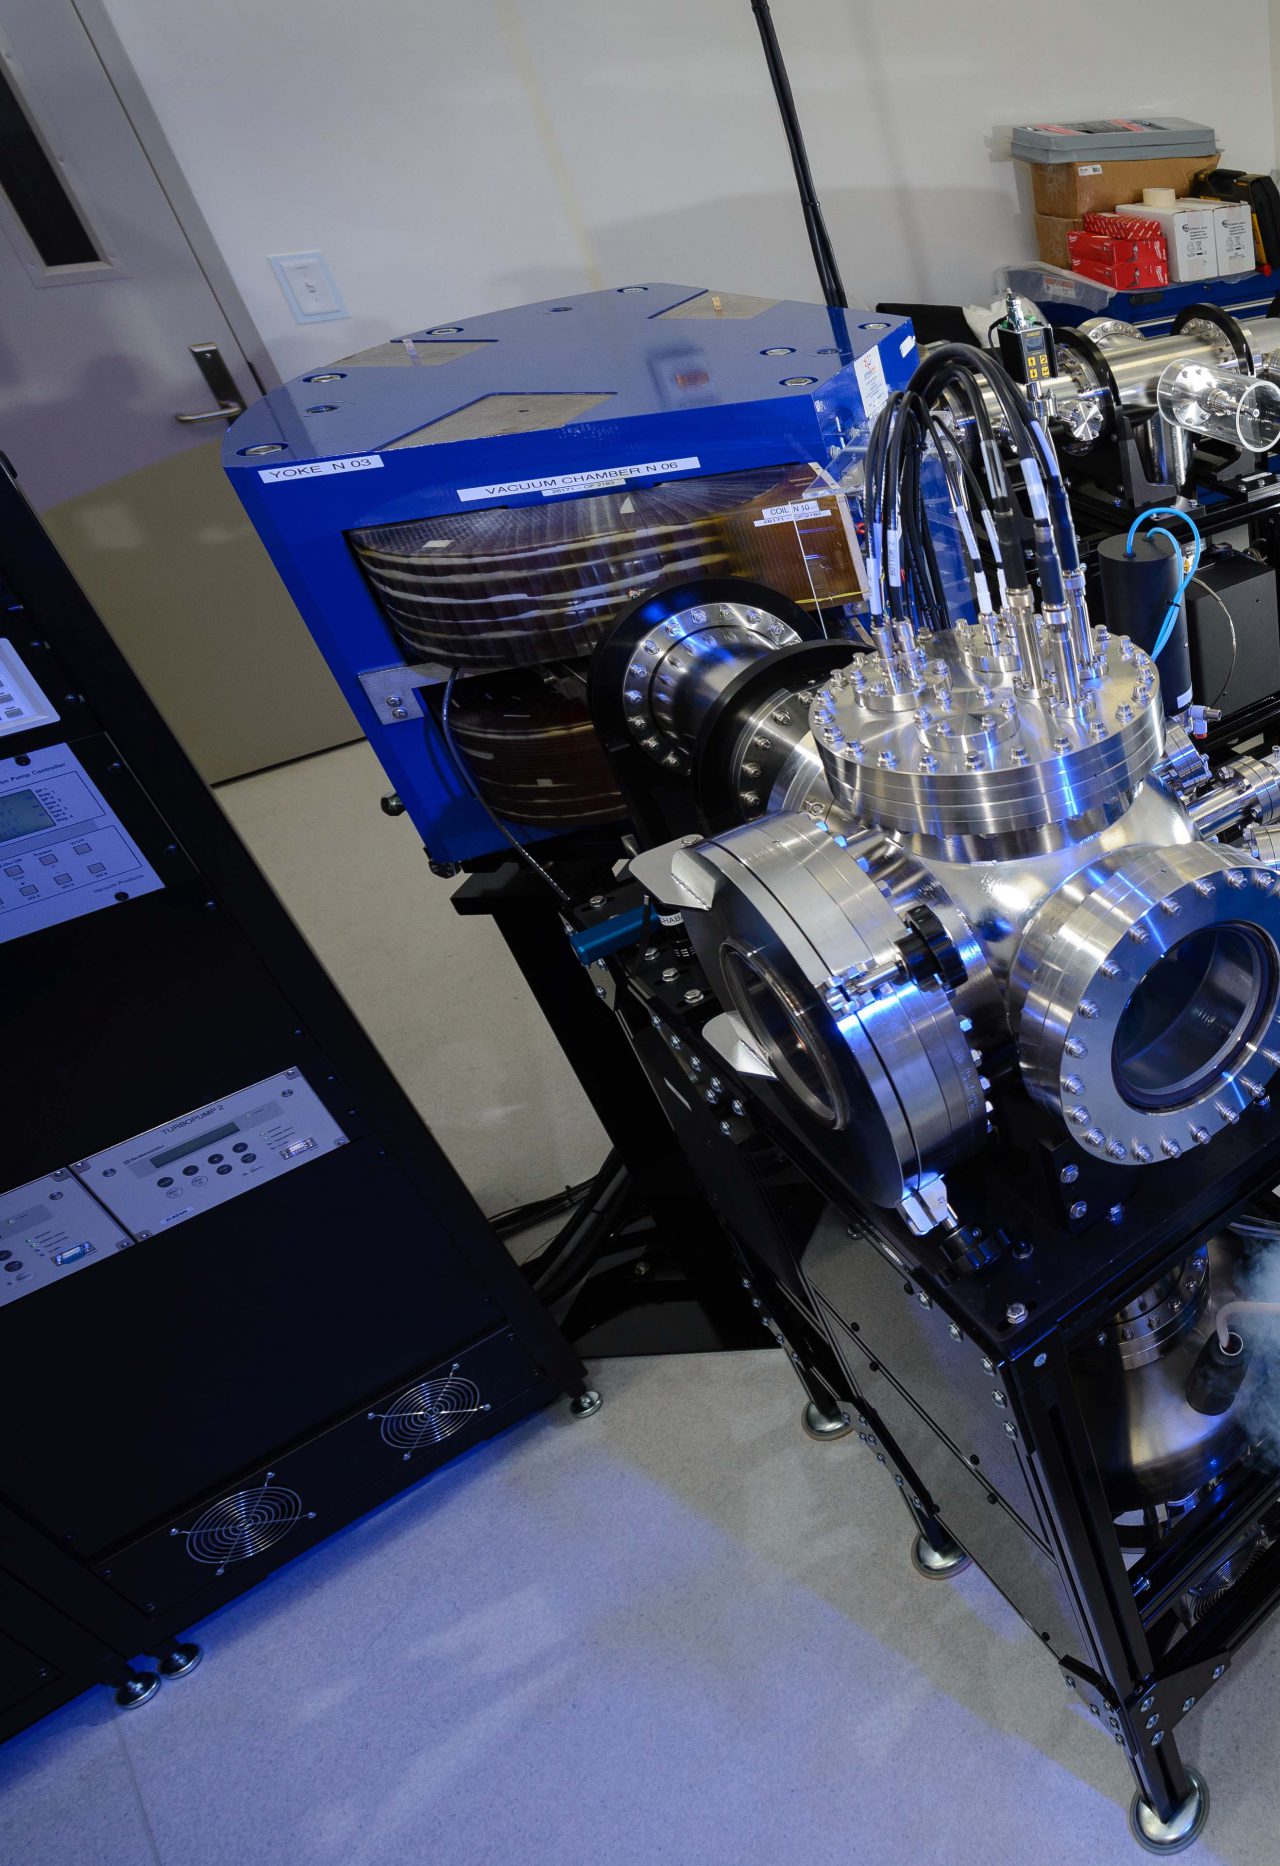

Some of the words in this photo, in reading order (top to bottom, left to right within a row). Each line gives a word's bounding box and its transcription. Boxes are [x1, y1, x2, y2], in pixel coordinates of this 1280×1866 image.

[269, 465, 323, 479] YOKE
[332, 462, 346, 470] N
[350, 459, 372, 468] 03
[485, 479, 557, 495] VACUUM
[562, 467, 641, 485] CHAMBER
[645, 464, 657, 472] N
[661, 461, 678, 470] 06
[770, 508, 789, 516] COIL
[10, 773, 31, 781] Pump
[32, 763, 66, 775] Controller
[92, 882, 118, 894] Vacuum
[118, 874, 144, 887] Products
[161, 1107, 216, 1135] TURBOPUMP
